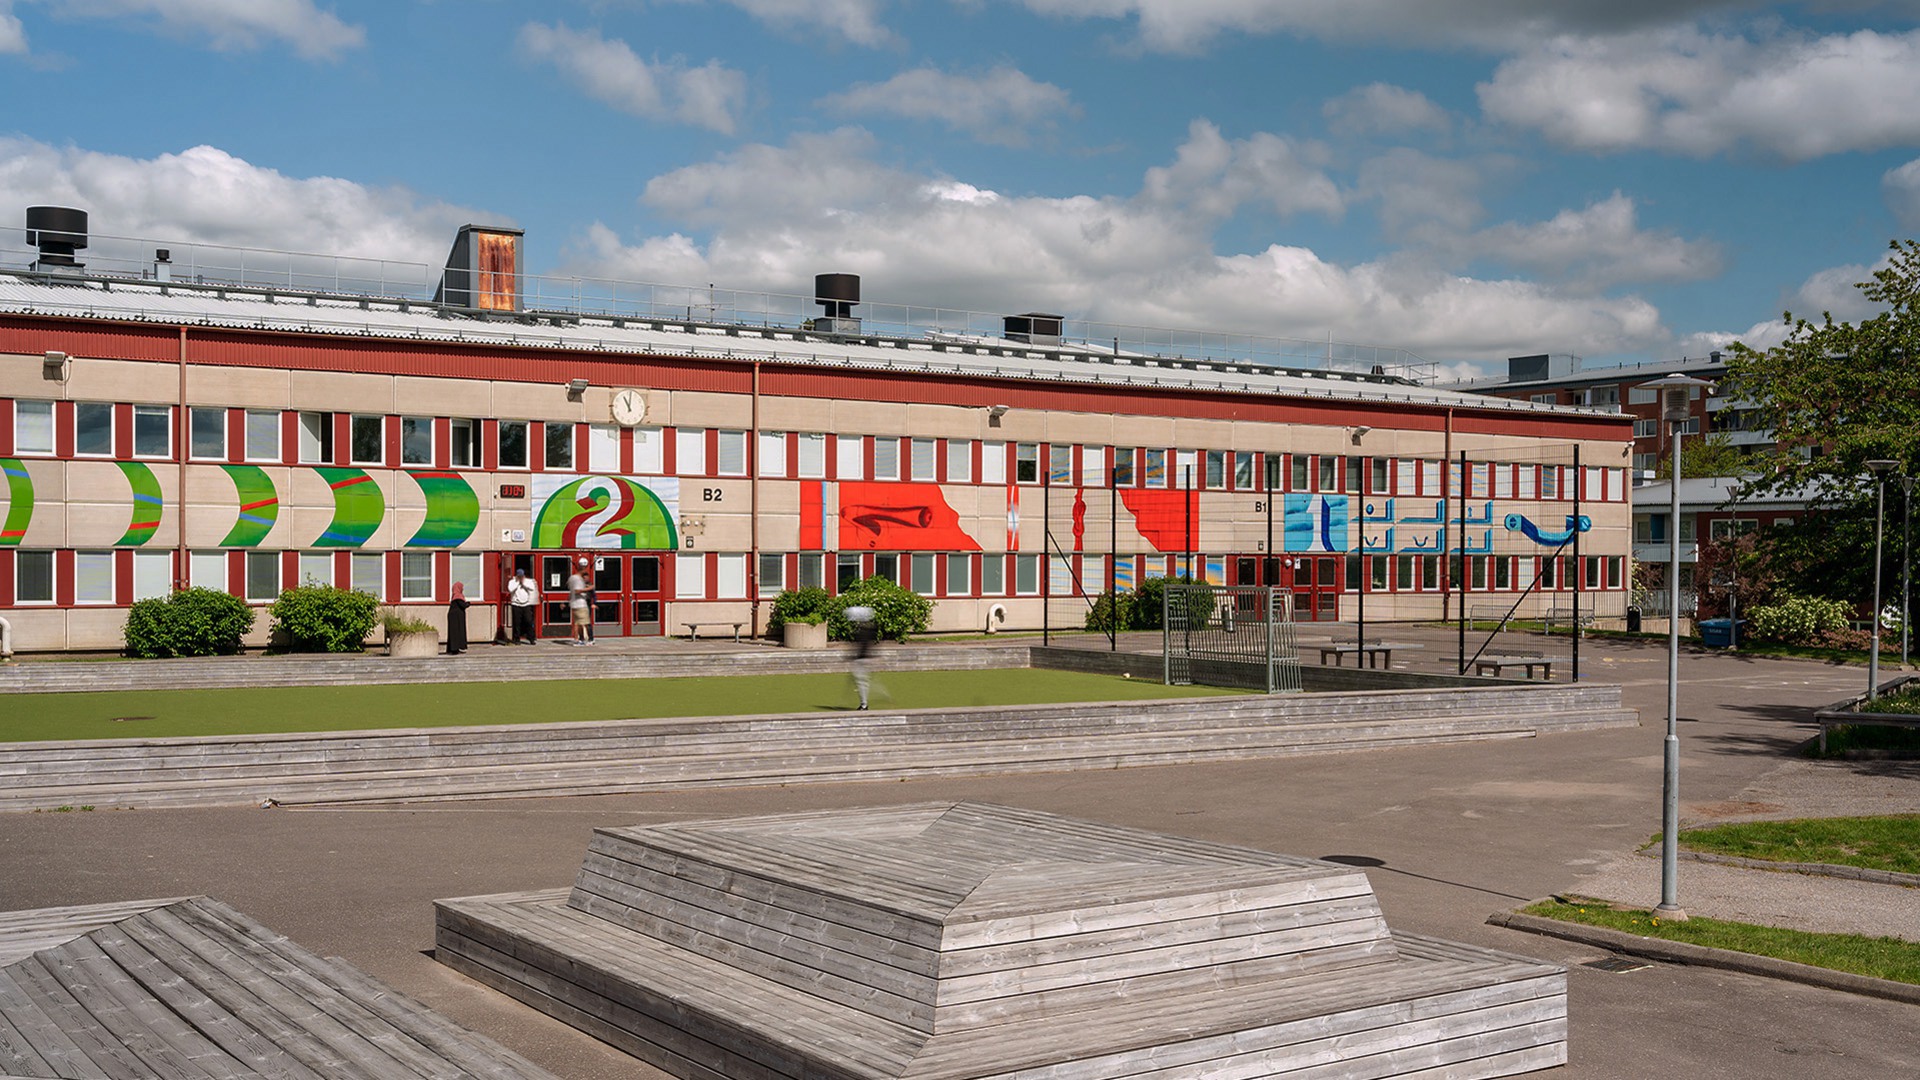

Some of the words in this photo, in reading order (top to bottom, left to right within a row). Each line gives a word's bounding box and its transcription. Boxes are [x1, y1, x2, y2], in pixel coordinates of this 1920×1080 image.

[703, 488, 722, 501] B2
[1255, 501, 1266, 513] B1
[563, 477, 635, 548] 2
[1306, 494, 1334, 551] 1
